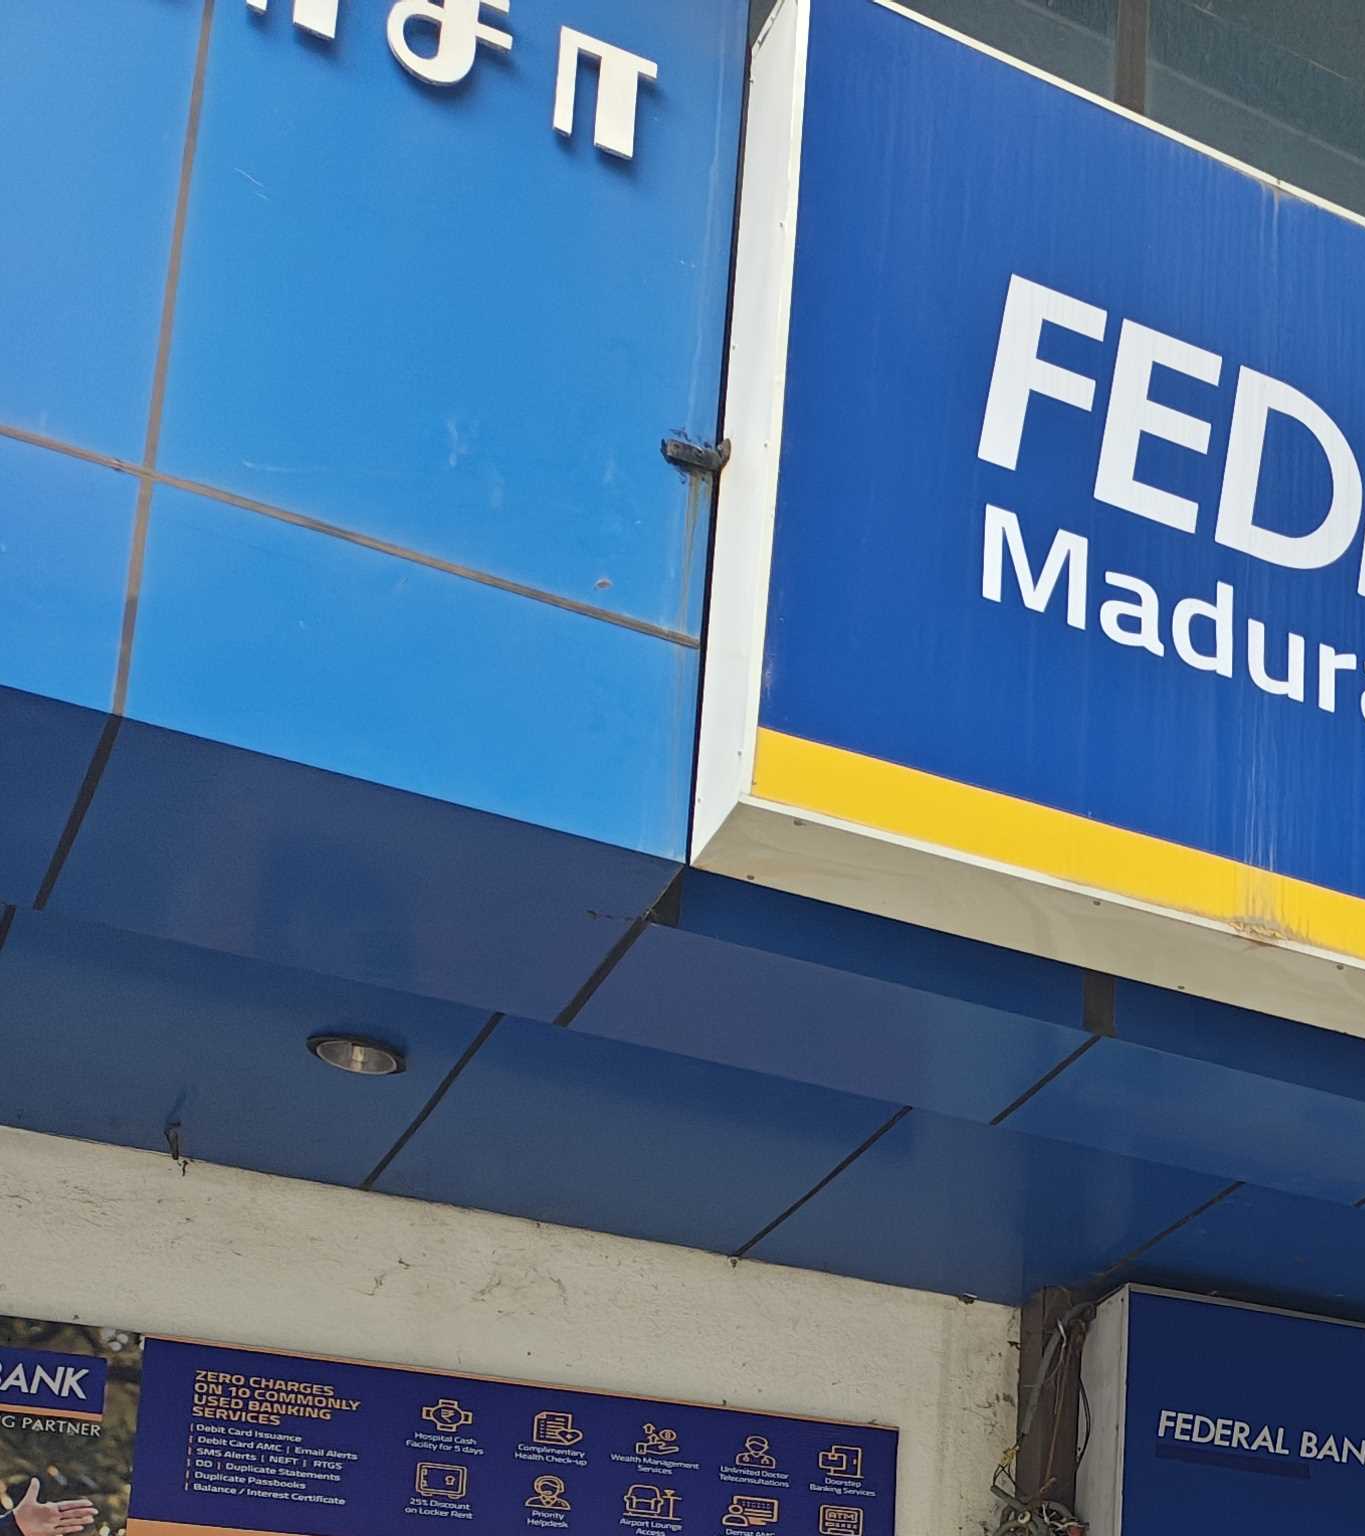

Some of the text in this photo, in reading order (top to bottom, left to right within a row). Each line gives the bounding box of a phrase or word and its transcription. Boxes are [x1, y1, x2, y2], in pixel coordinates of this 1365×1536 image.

[0, 1362, 90, 1400] ANK
[195, 1370, 335, 1396] ZERO CHARGES
[194, 1383, 361, 1411] ON 10 COMMONLY
[194, 1394, 332, 1420] USED BANKING
[22, 1416, 101, 1437] PARTNER
[192, 1406, 281, 1426] SERVICES
[1157, 1409, 1289, 1456] FEDERAL
